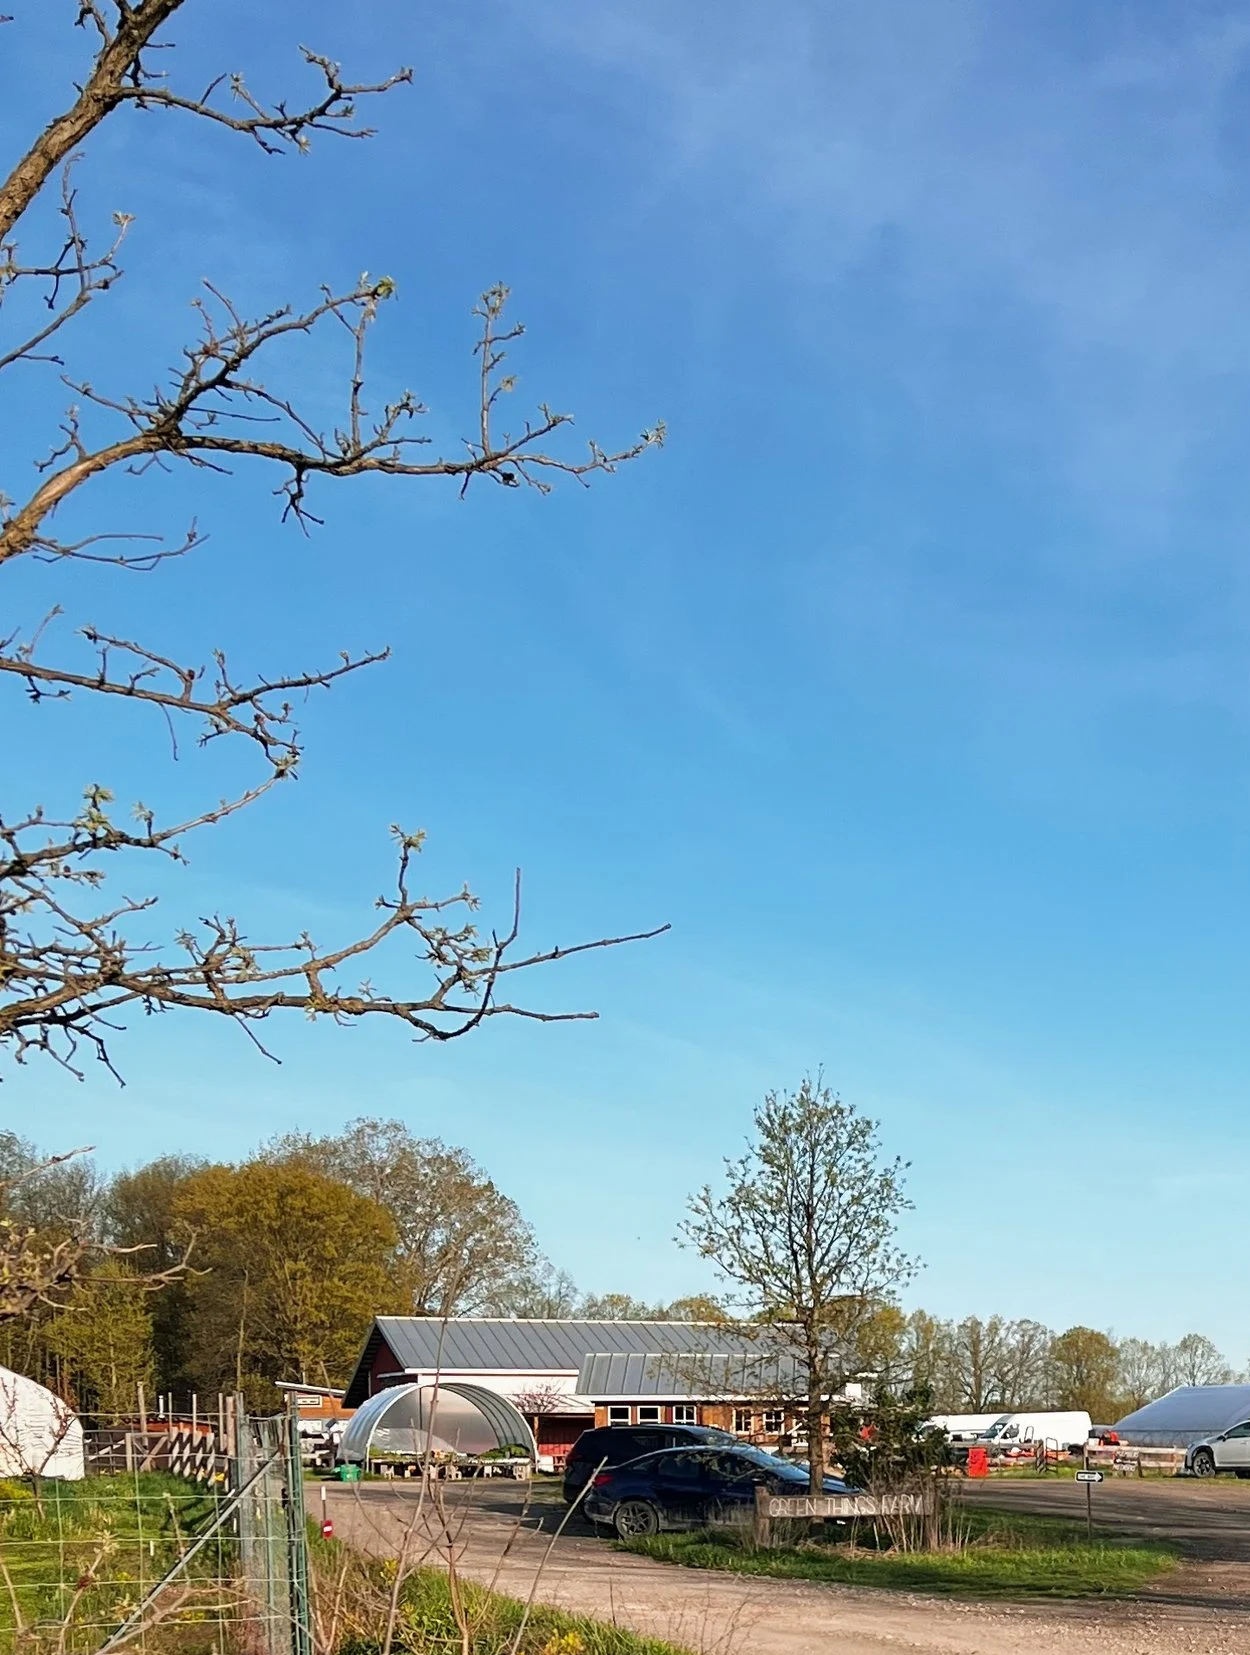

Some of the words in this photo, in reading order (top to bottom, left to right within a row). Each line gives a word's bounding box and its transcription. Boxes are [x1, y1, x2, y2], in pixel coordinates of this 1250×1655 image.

[768, 1498, 817, 1517] GREEN
[825, 1496, 876, 1515] THINGS
[881, 1494, 923, 1515] FARM
